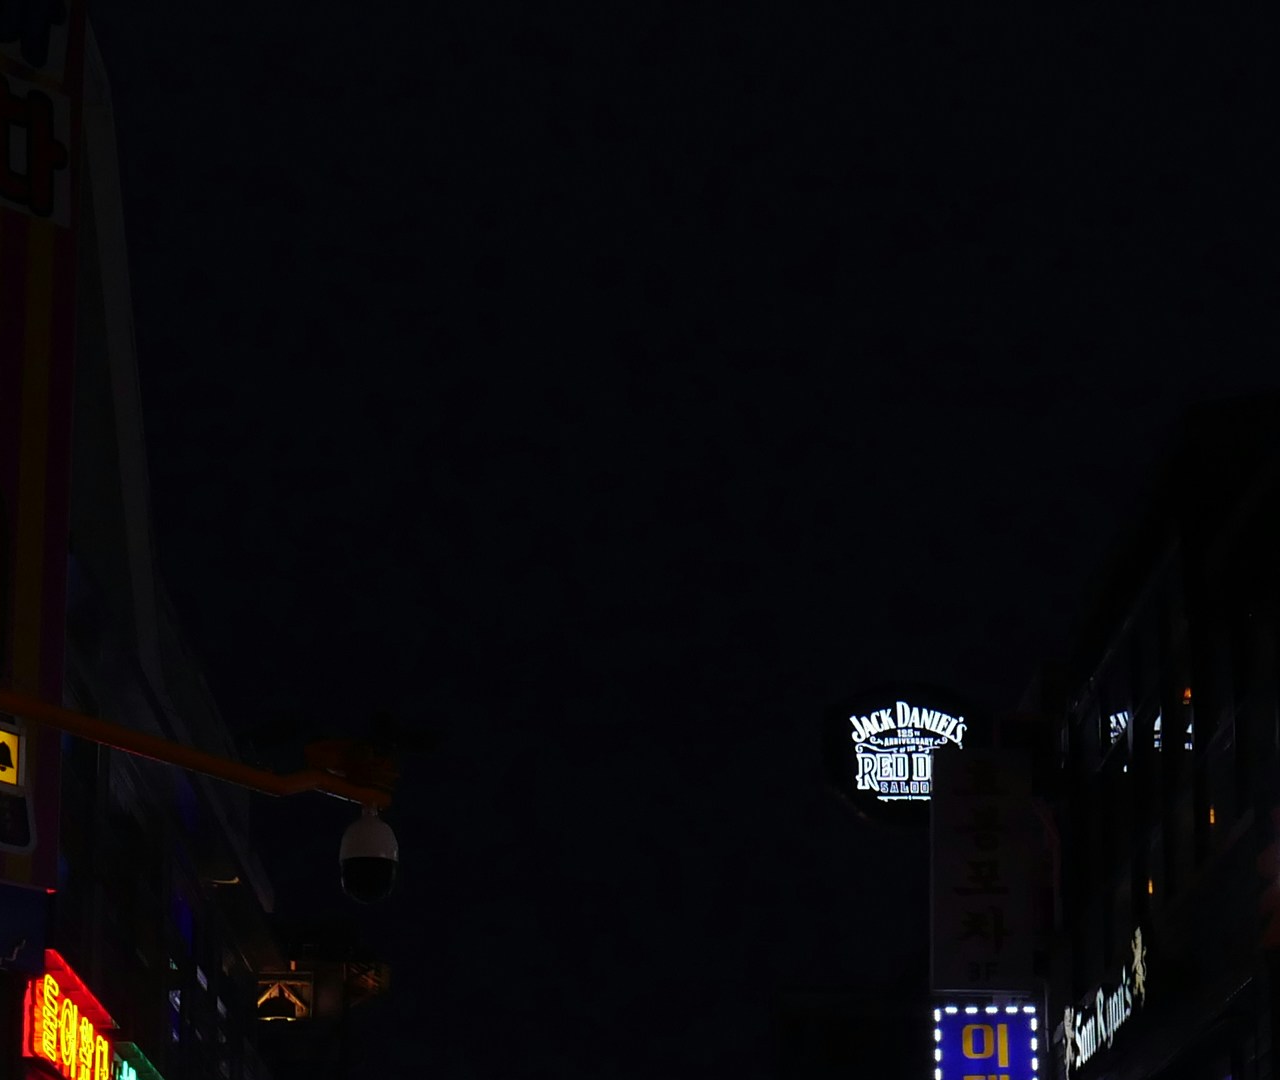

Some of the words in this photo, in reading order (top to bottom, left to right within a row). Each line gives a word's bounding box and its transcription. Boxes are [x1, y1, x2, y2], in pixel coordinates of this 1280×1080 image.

[850, 708, 897, 743] JACK
[896, 701, 968, 746] DANIEL'S
[884, 737, 934, 747] ANNIVERSARY
[879, 781, 930, 794] SALOO
